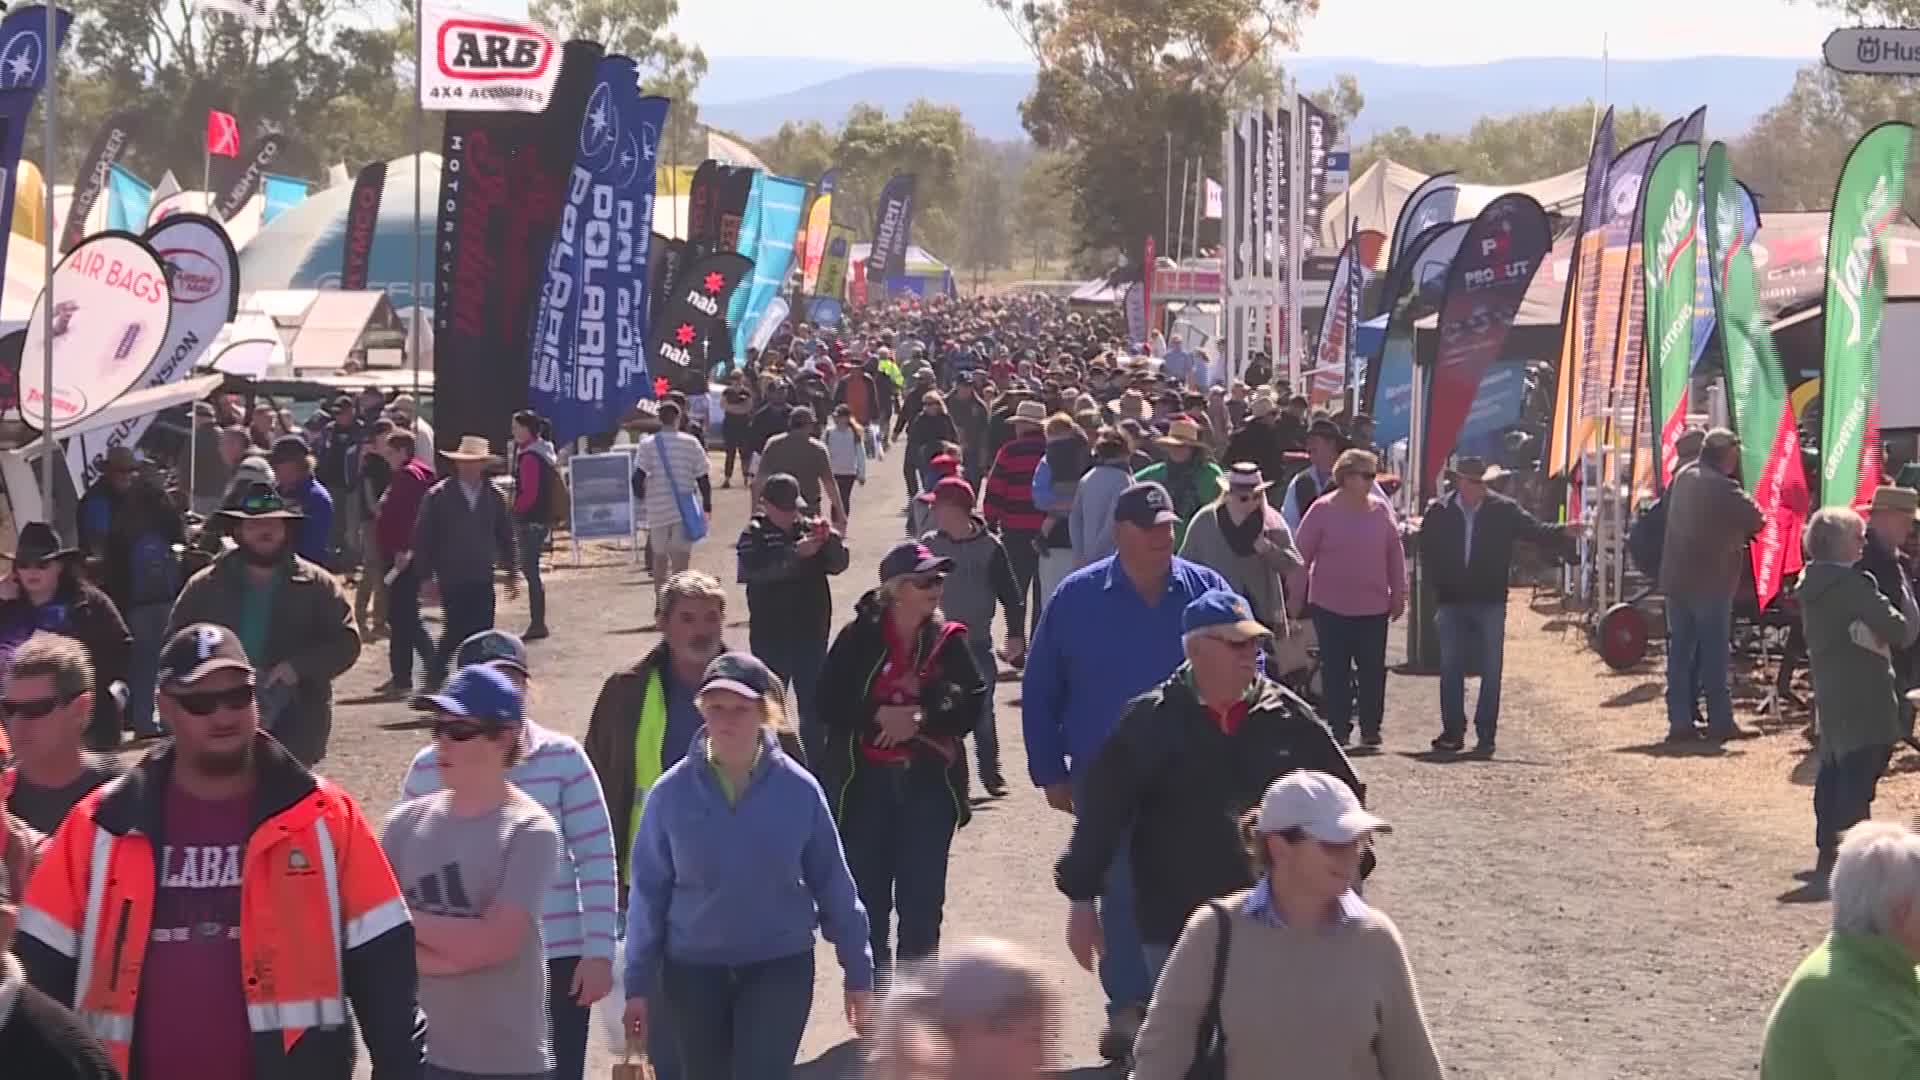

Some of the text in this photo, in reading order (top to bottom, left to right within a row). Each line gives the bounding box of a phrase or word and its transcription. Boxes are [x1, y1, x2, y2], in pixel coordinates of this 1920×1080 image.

[453, 32, 540, 69] ARB
[1883, 41, 1920, 61] Hus
[71, 250, 105, 281] AIR
[105, 259, 166, 304] BAGS
[538, 165, 592, 393] POLARIS
[577, 184, 613, 402] POLARIS
[687, 288, 719, 317] nab
[659, 341, 691, 368] nab
[194, 624, 225, 659] P
